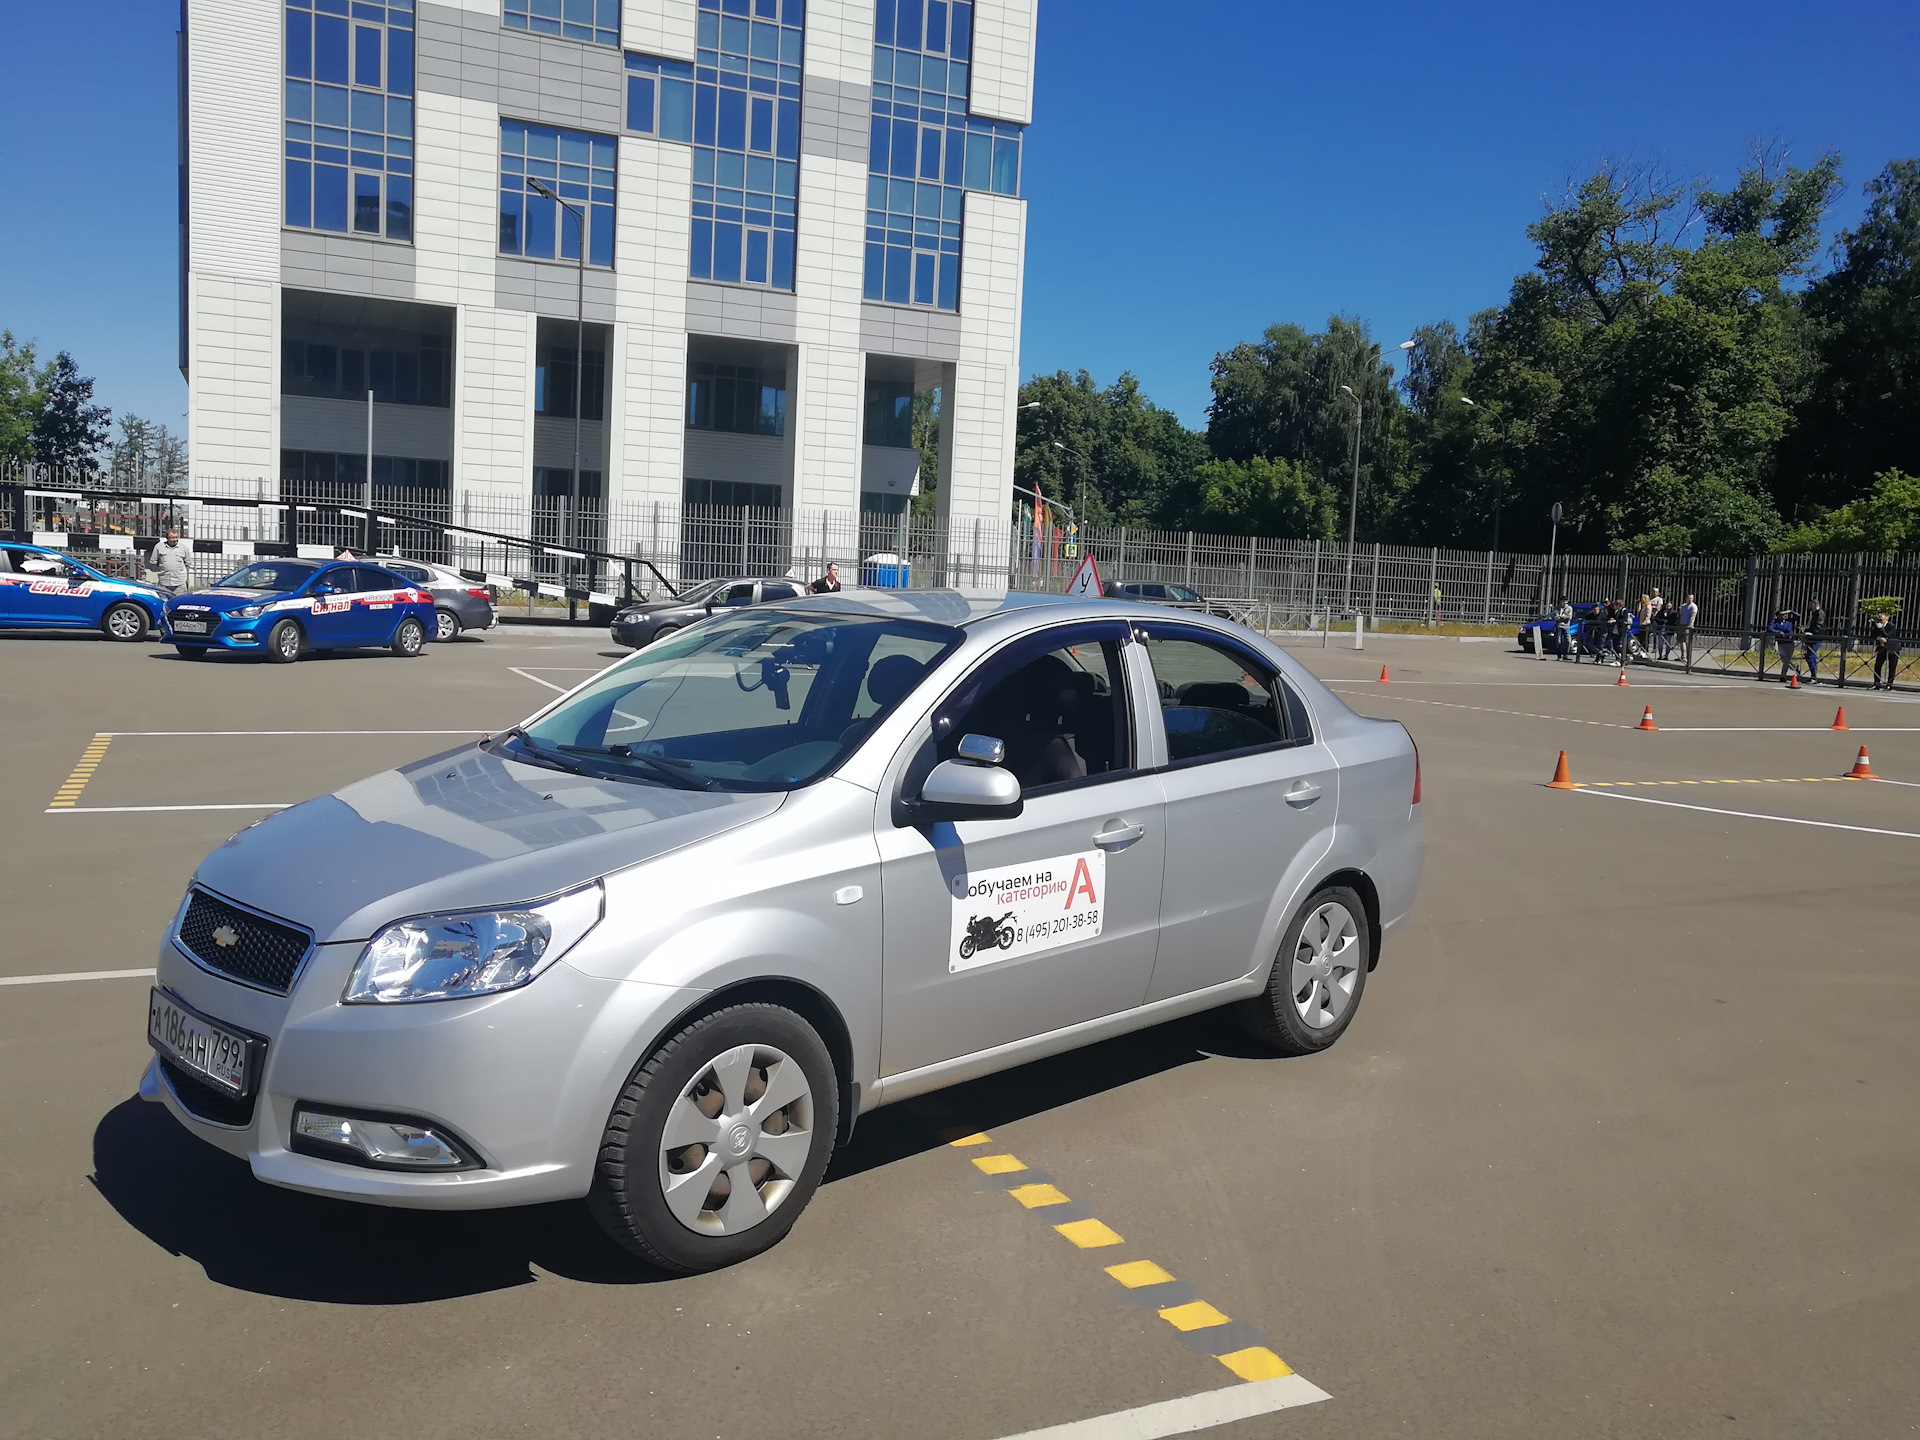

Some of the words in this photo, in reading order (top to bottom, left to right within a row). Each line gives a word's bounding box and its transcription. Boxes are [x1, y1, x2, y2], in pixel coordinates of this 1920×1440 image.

[31, 580, 92, 596] Сигнал
[968, 876, 1033, 897] обучаем
[1036, 871, 1052, 886] на
[997, 880, 1067, 905] категорию
[1016, 928, 1024, 942] 8
[1025, 921, 1051, 943] (495)
[1052, 910, 1099, 934] 201-38-58
[213, 1029, 240, 1068] 799
[216, 1063, 231, 1080] RUS
